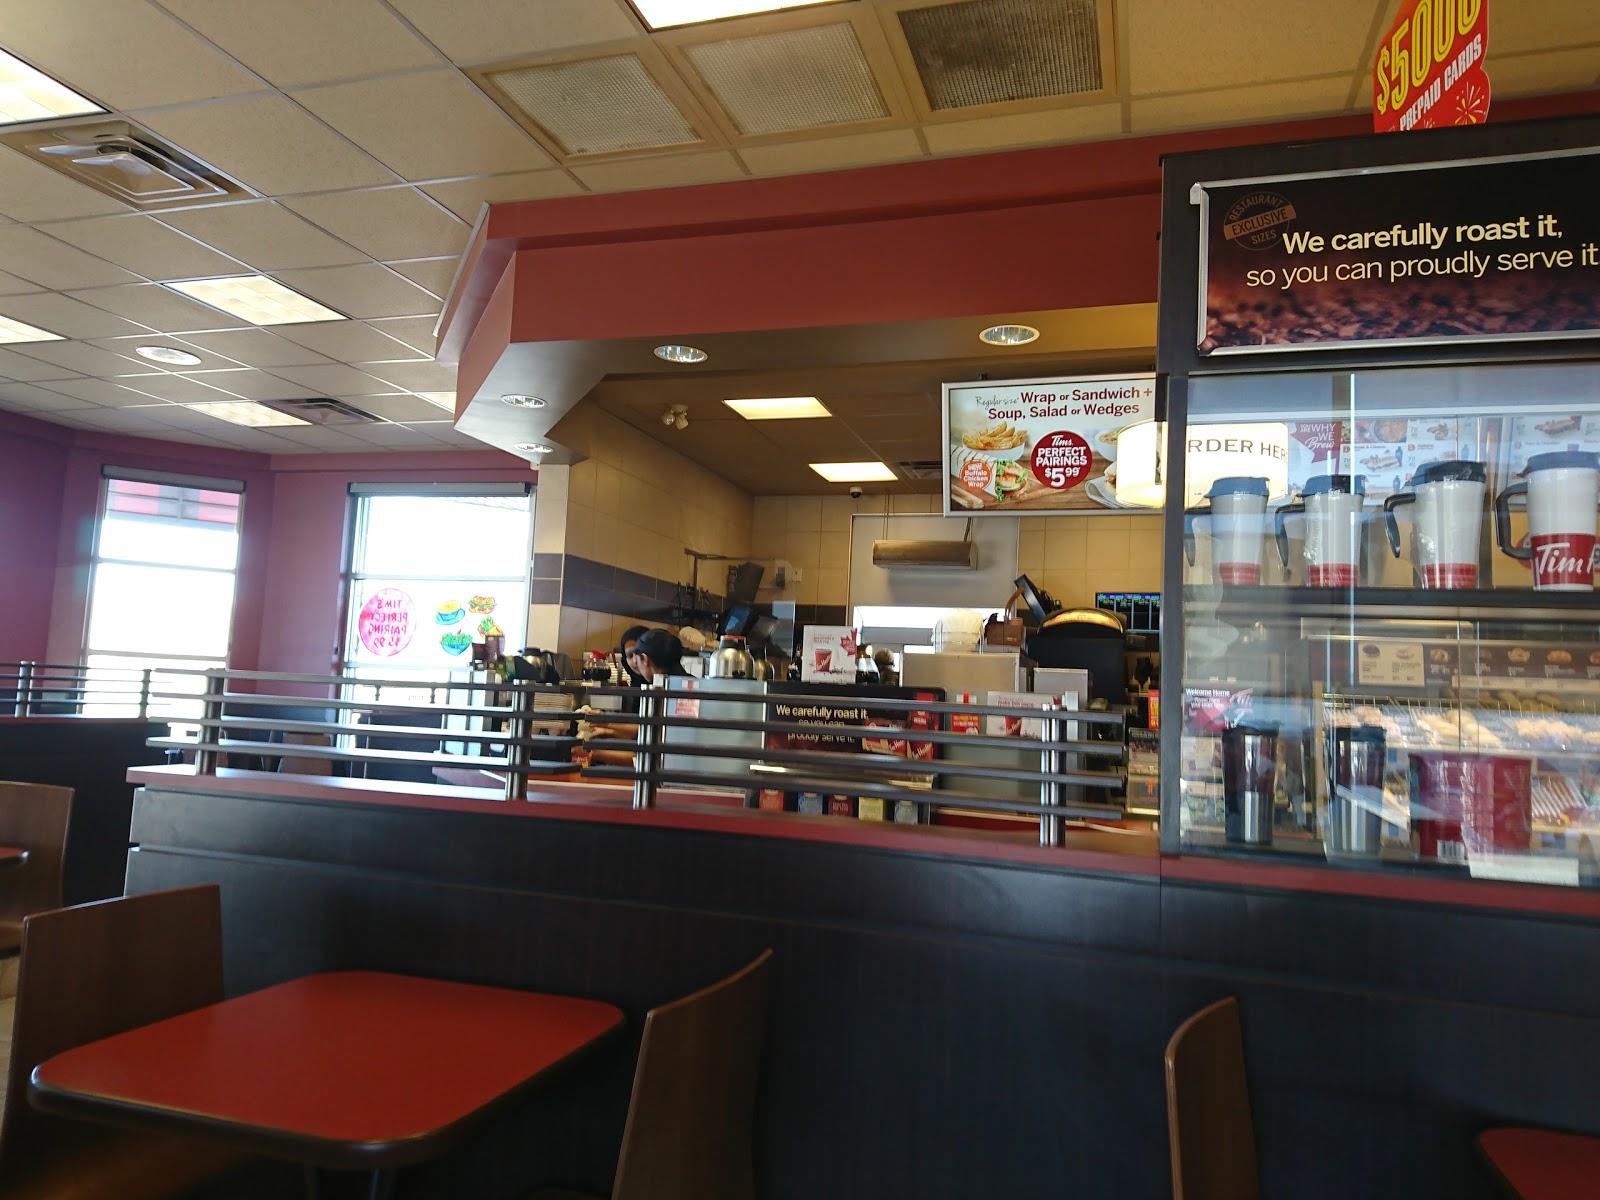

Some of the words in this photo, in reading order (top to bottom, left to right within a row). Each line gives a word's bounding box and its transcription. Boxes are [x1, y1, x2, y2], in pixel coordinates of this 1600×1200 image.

[1400, 77, 1441, 131] PREPAID
[1444, 33, 1482, 91] CARDS
[1229, 194, 1283, 220] RESTAURANT
[1231, 208, 1289, 236] EXCLUSIVE
[1251, 229, 1277, 245] SIZES
[1282, 231, 1325, 254] We
[1331, 222, 1449, 251] carefully
[1455, 216, 1530, 243] roast
[1537, 214, 1563, 239] it,
[1246, 268, 1276, 287] so
[1281, 265, 1328, 290] you
[1335, 261, 1383, 281] can
[1390, 250, 1491, 283] proudly
[1497, 250, 1573, 271] serve
[1021, 392, 1056, 406] Wrap
[1059, 393, 1070, 401] or
[1072, 387, 1140, 401] Sandwich
[988, 408, 1026, 421] Soup,
[1030, 405, 1068, 418] Salad
[1084, 403, 1140, 417] Wedges
[1311, 423, 1336, 432] WHY
[1318, 431, 1335, 441] WE
[1051, 435, 1072, 447] Tims
[1304, 436, 1335, 450] Brew
[1037, 447, 1086, 457] PERFECT
[1188, 438, 1254, 454] RDER
[1260, 442, 1288, 464] HER
[1036, 456, 1088, 467] PAIRINGS
[1536, 542, 1584, 575] Tim
[1185, 688, 1212, 696] Welcome
[1213, 688, 1231, 697] Home
[776, 704, 791, 716] We
[792, 705, 833, 720] carefully
[833, 707, 859, 720] roast
